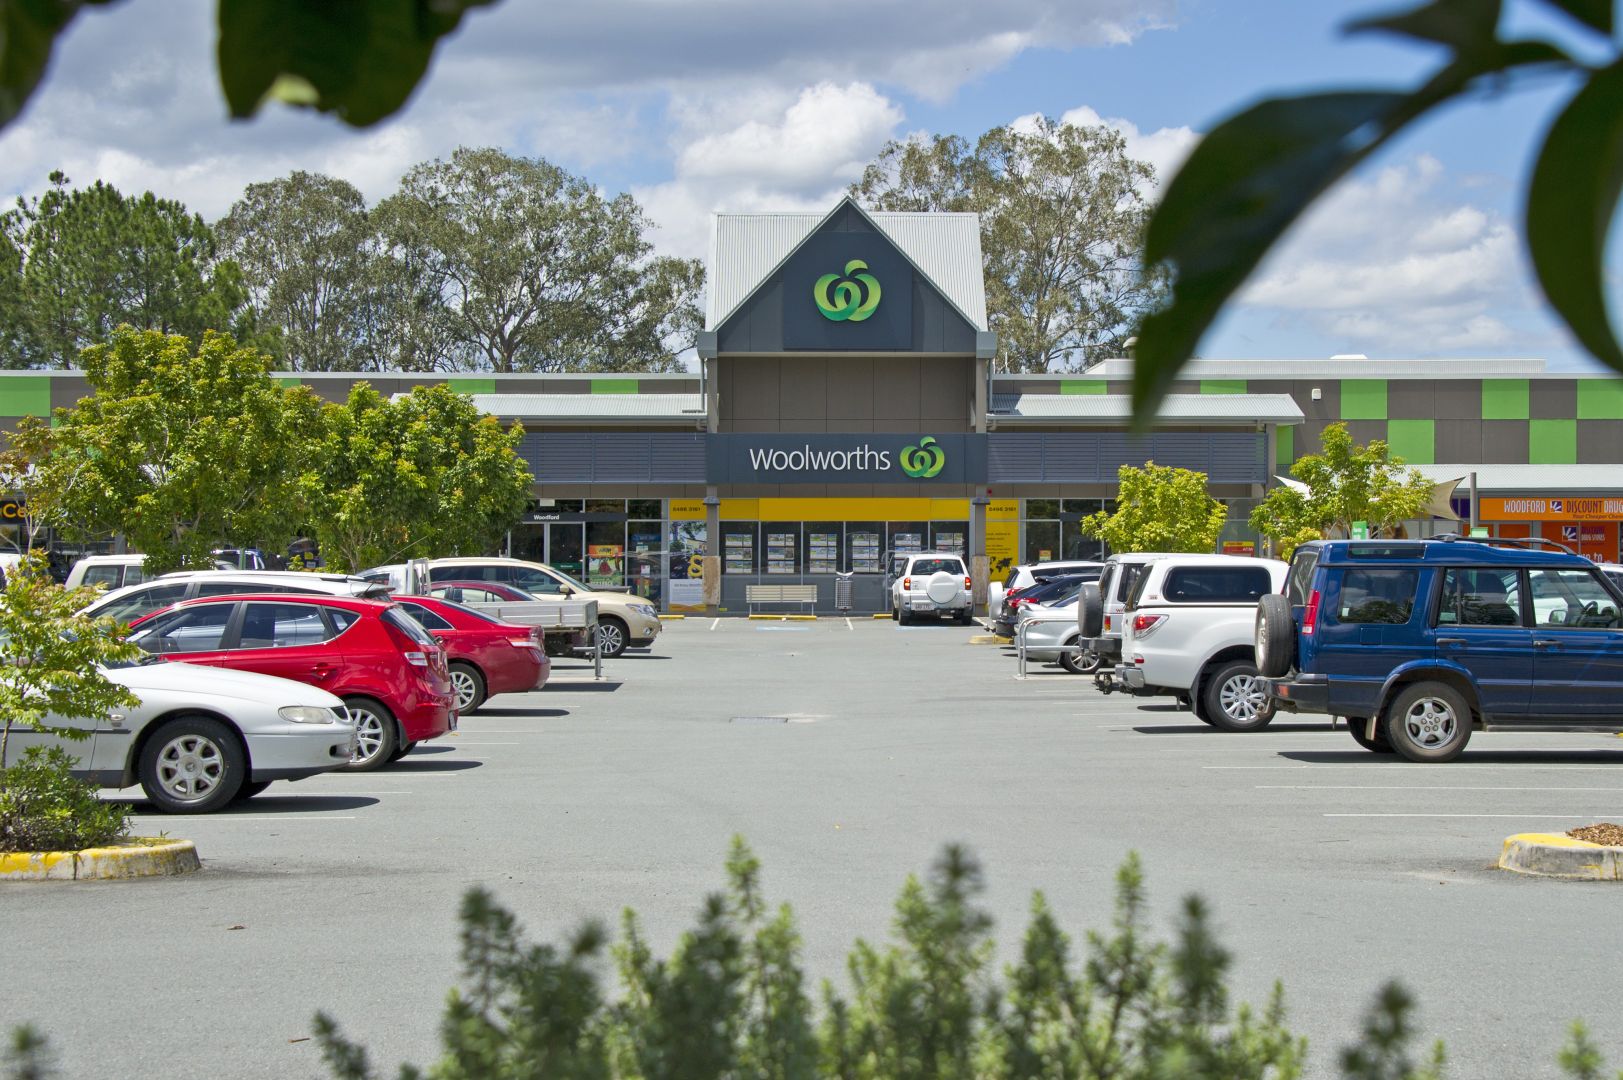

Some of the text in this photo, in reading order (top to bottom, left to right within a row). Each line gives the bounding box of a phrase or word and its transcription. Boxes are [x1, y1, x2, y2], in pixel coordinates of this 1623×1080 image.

[749, 444, 891, 471] Woolworths
[1504, 500, 1623, 513] WOODFORD DISCOUNT DRUG
